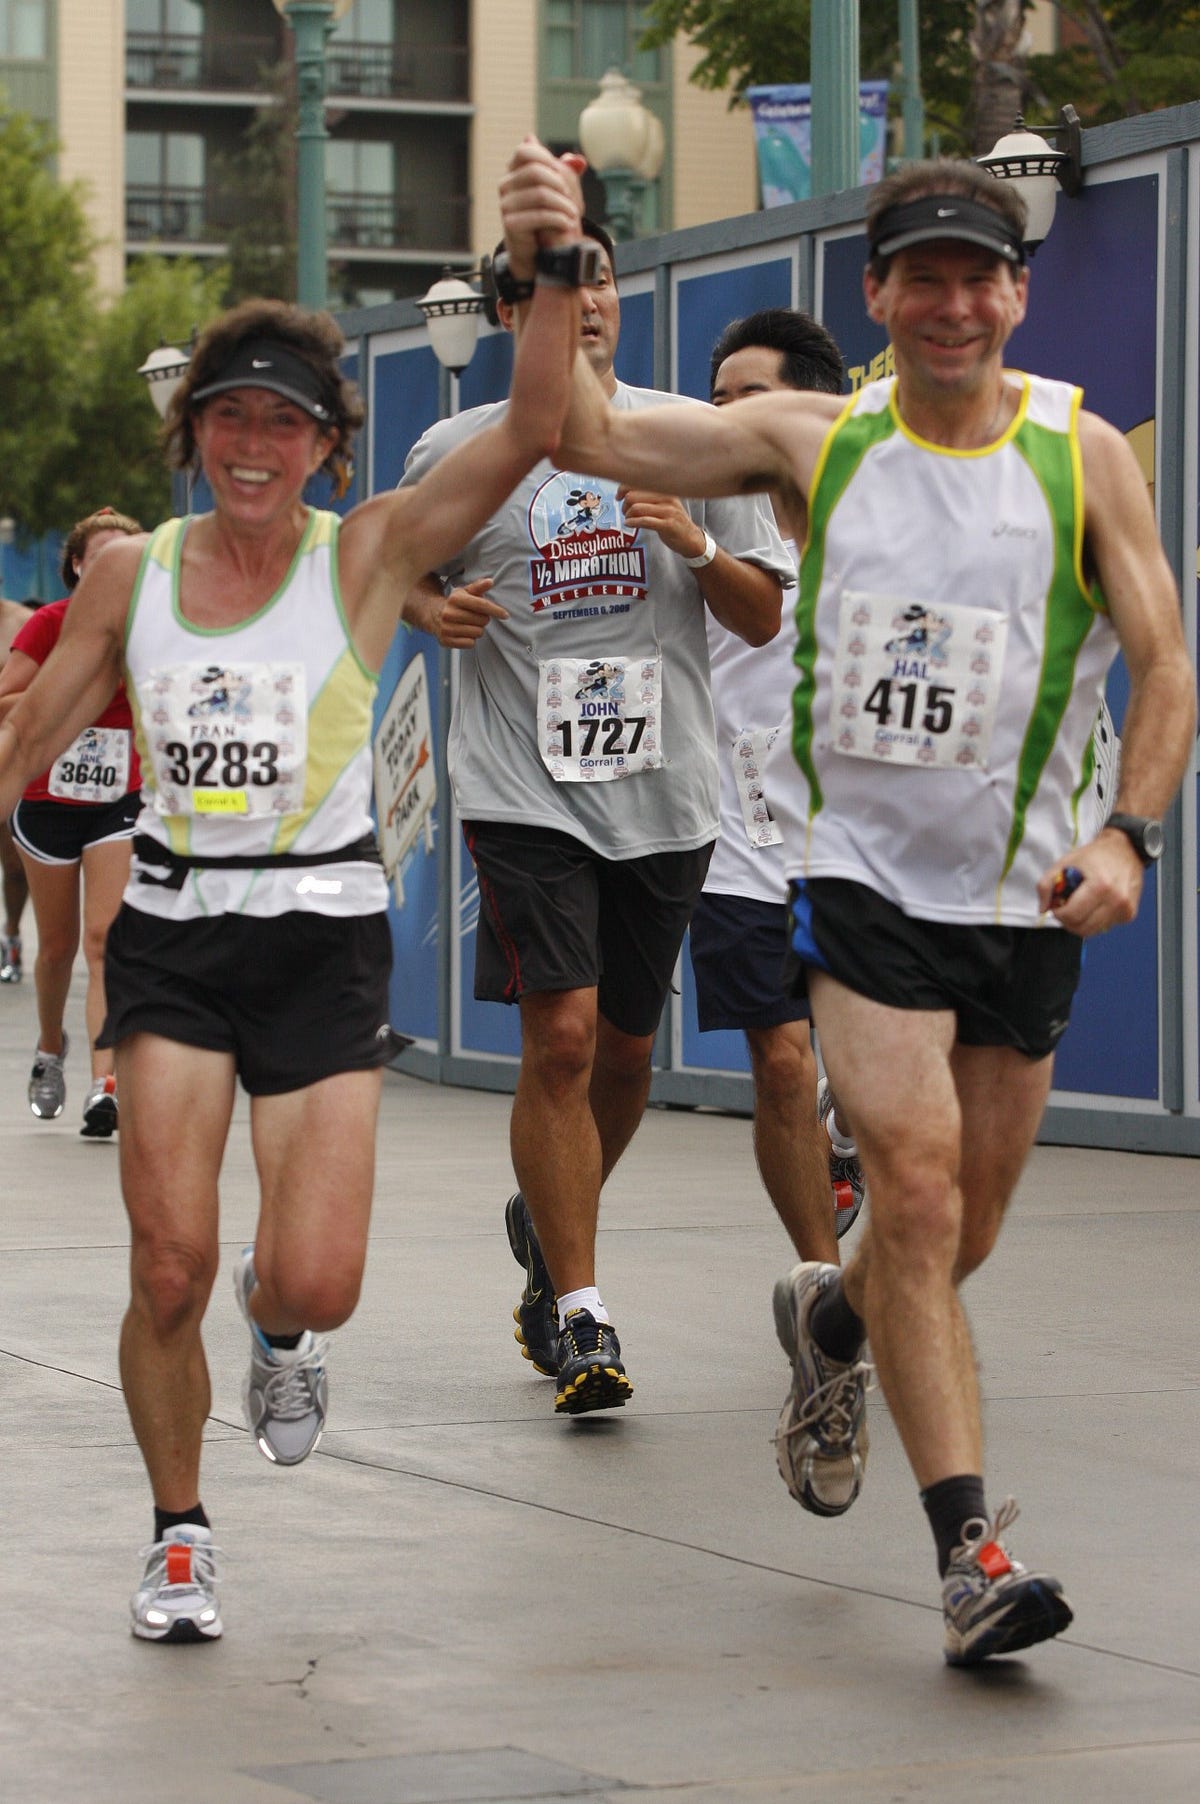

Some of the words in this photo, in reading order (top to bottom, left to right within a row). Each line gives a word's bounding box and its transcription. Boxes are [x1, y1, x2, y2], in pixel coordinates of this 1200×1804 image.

[848, 343, 896, 394] THER
[549, 530, 625, 560] Disneyland
[554, 551, 642, 584] MARATHON
[541, 585, 639, 607] WEEKEND
[552, 606, 600, 620] SEPTEMBER
[892, 659, 929, 680] HAL
[581, 702, 618, 717] JOHN
[864, 678, 955, 734] 415
[190, 724, 237, 739] FRAN
[386, 707, 418, 776] TODAY
[557, 717, 646, 757] 1727
[80, 754, 101, 764] JANE
[166, 741, 278, 788] 3283
[617, 757, 625, 766] B
[60, 762, 116, 787] 3640
[395, 782, 421, 838] PARK
